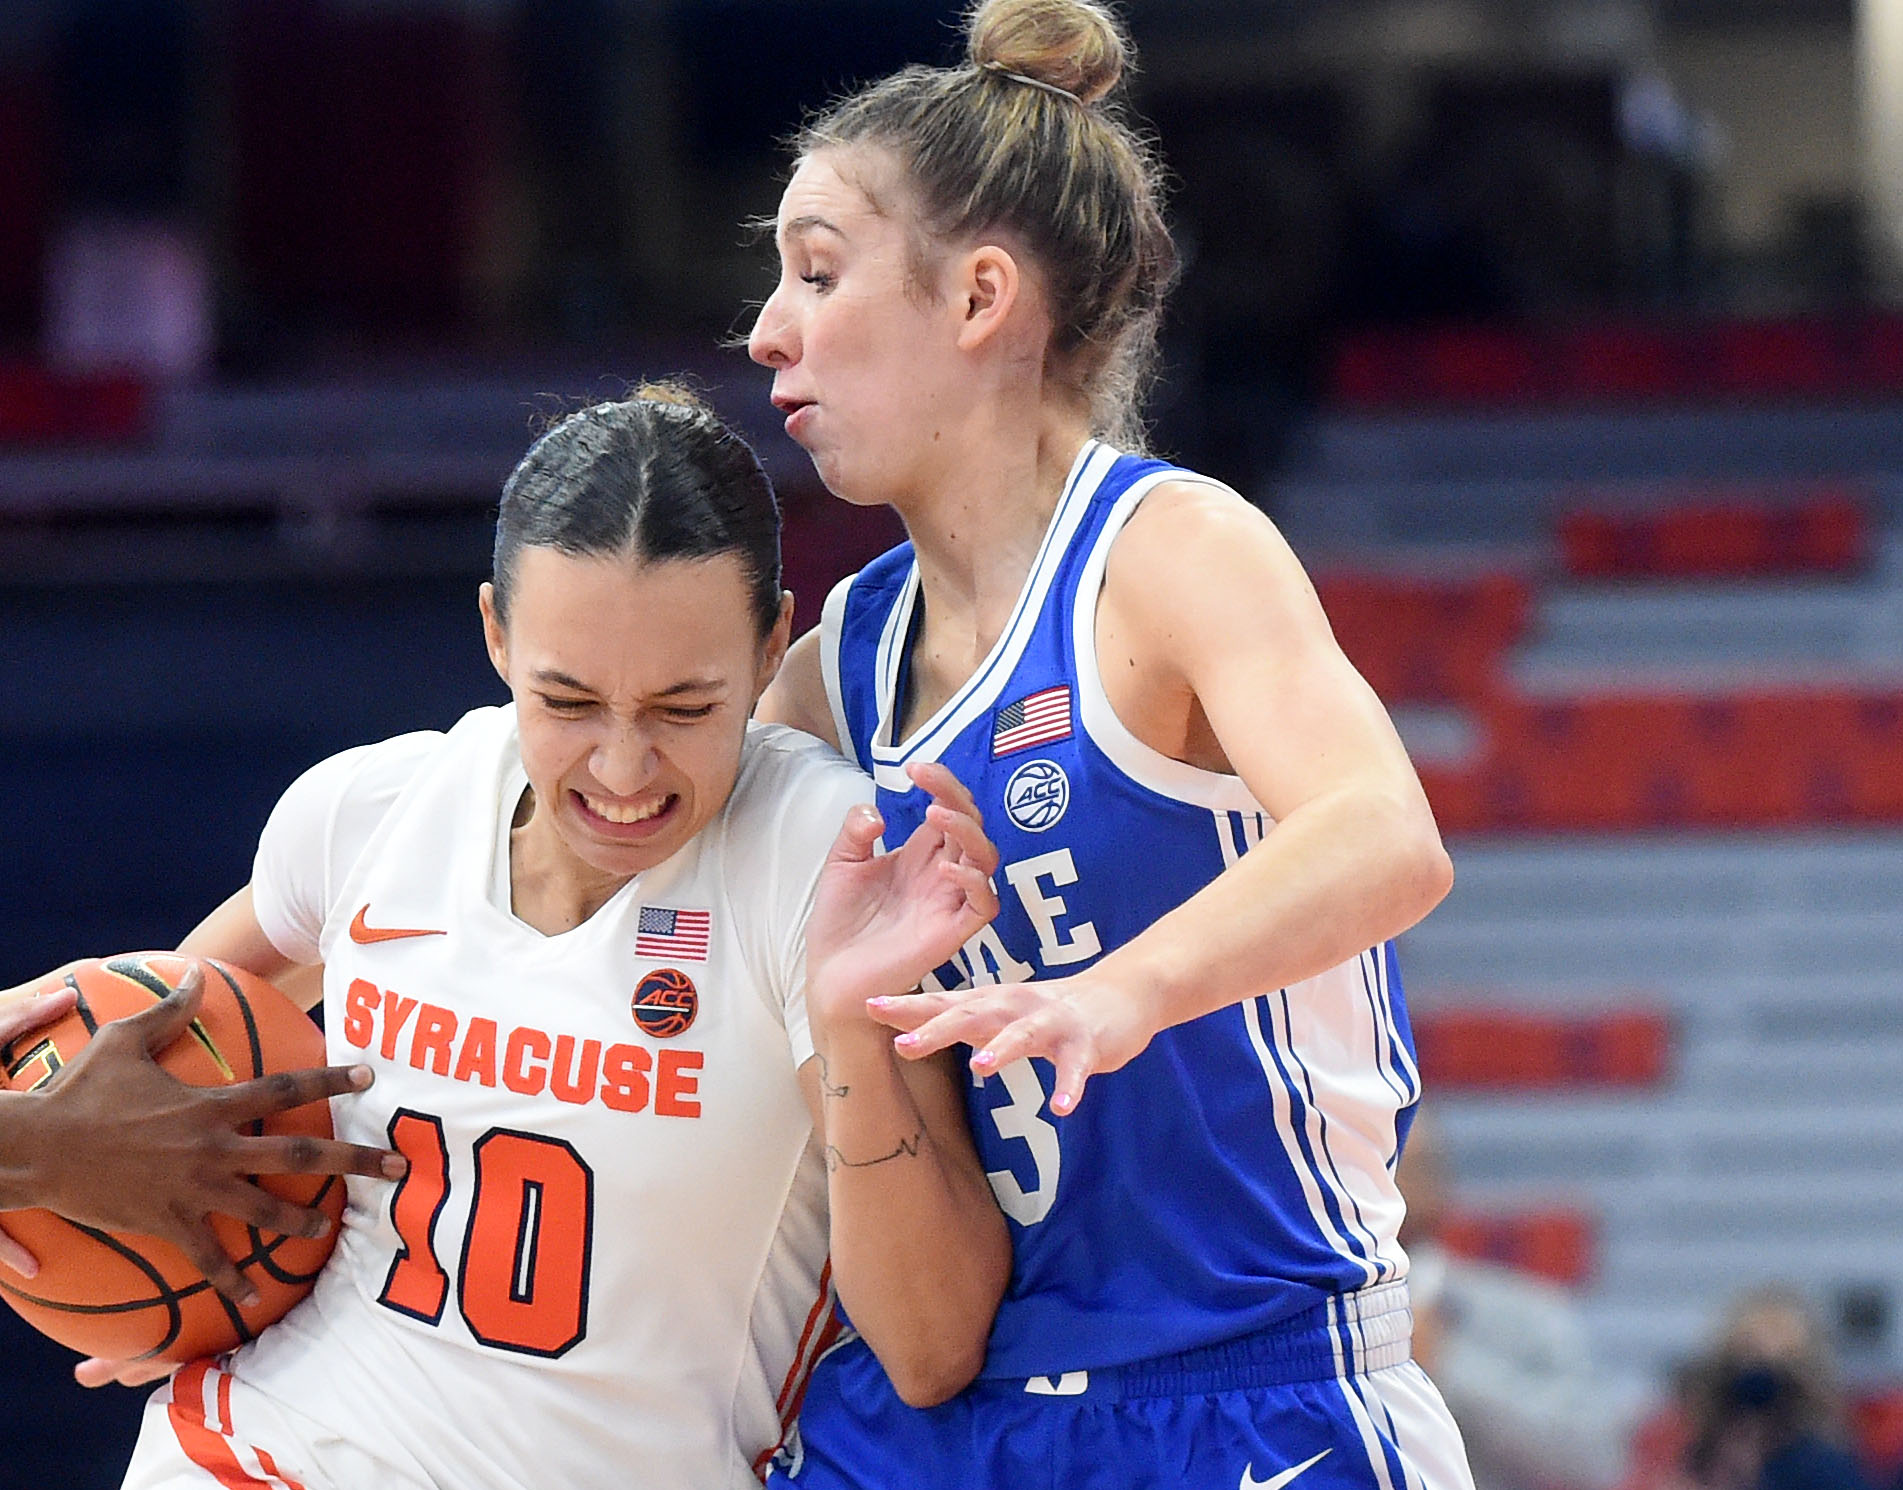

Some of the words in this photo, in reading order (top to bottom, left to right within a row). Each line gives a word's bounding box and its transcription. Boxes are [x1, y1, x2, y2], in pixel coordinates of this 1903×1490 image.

[1016, 776, 1062, 805] ACC
[638, 987, 697, 1008] ACC
[343, 976, 705, 1119] SYRACUSE
[376, 1106, 595, 1360] 10
